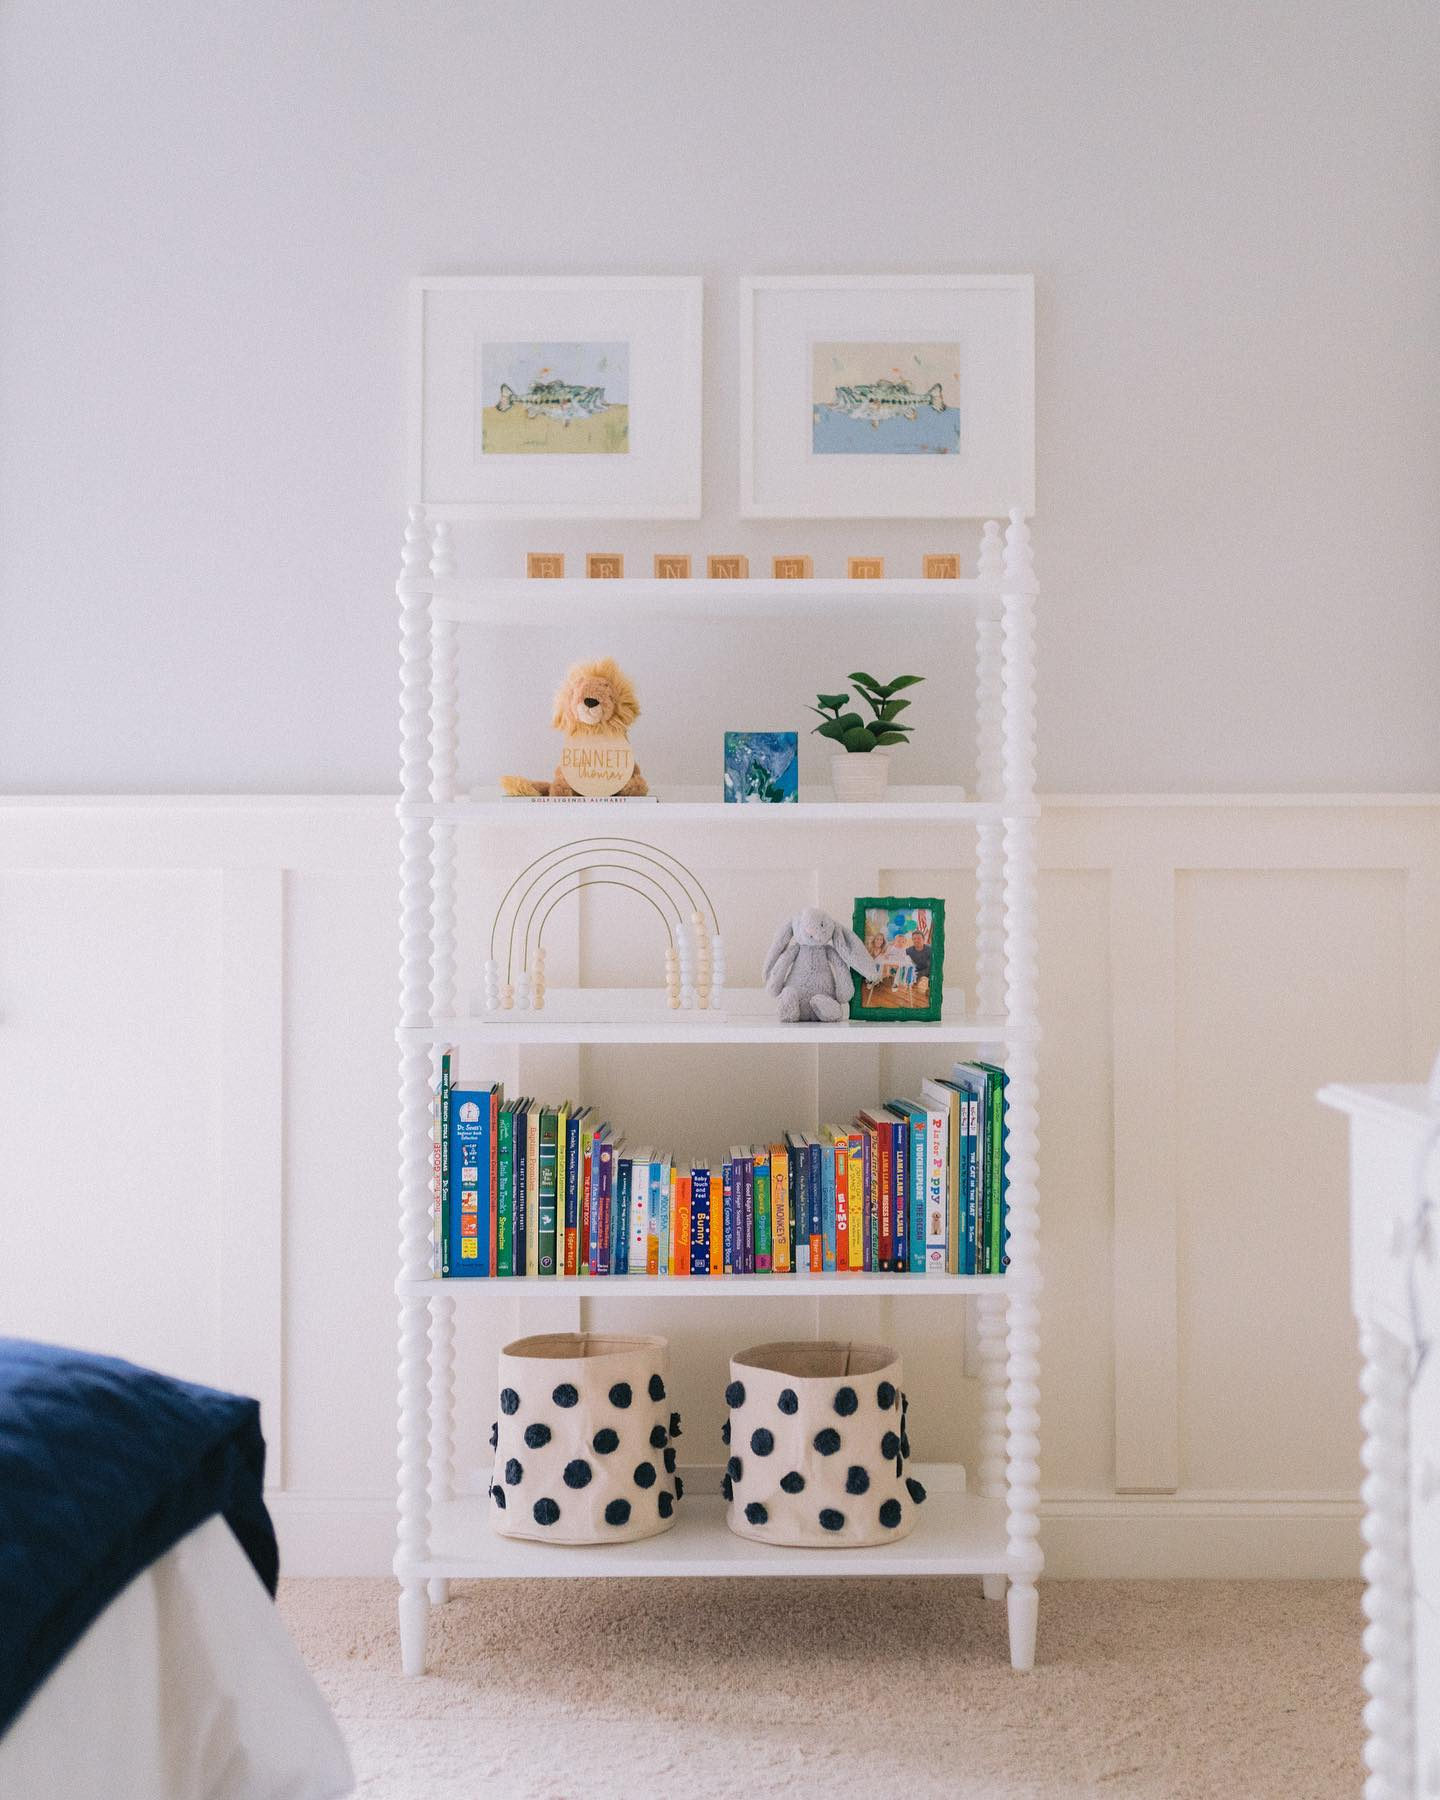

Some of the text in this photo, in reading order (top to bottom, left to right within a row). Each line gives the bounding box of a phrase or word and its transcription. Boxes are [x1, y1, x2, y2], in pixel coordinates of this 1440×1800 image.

[562, 748, 630, 768] BENNETT
[528, 1128, 536, 1158] Baptism
[931, 1120, 942, 1204] P is for Puppy
[776, 1204, 786, 1244] MONKEY'S
[838, 1193, 847, 1230] ELMO
[695, 1213, 706, 1245] Bunny
